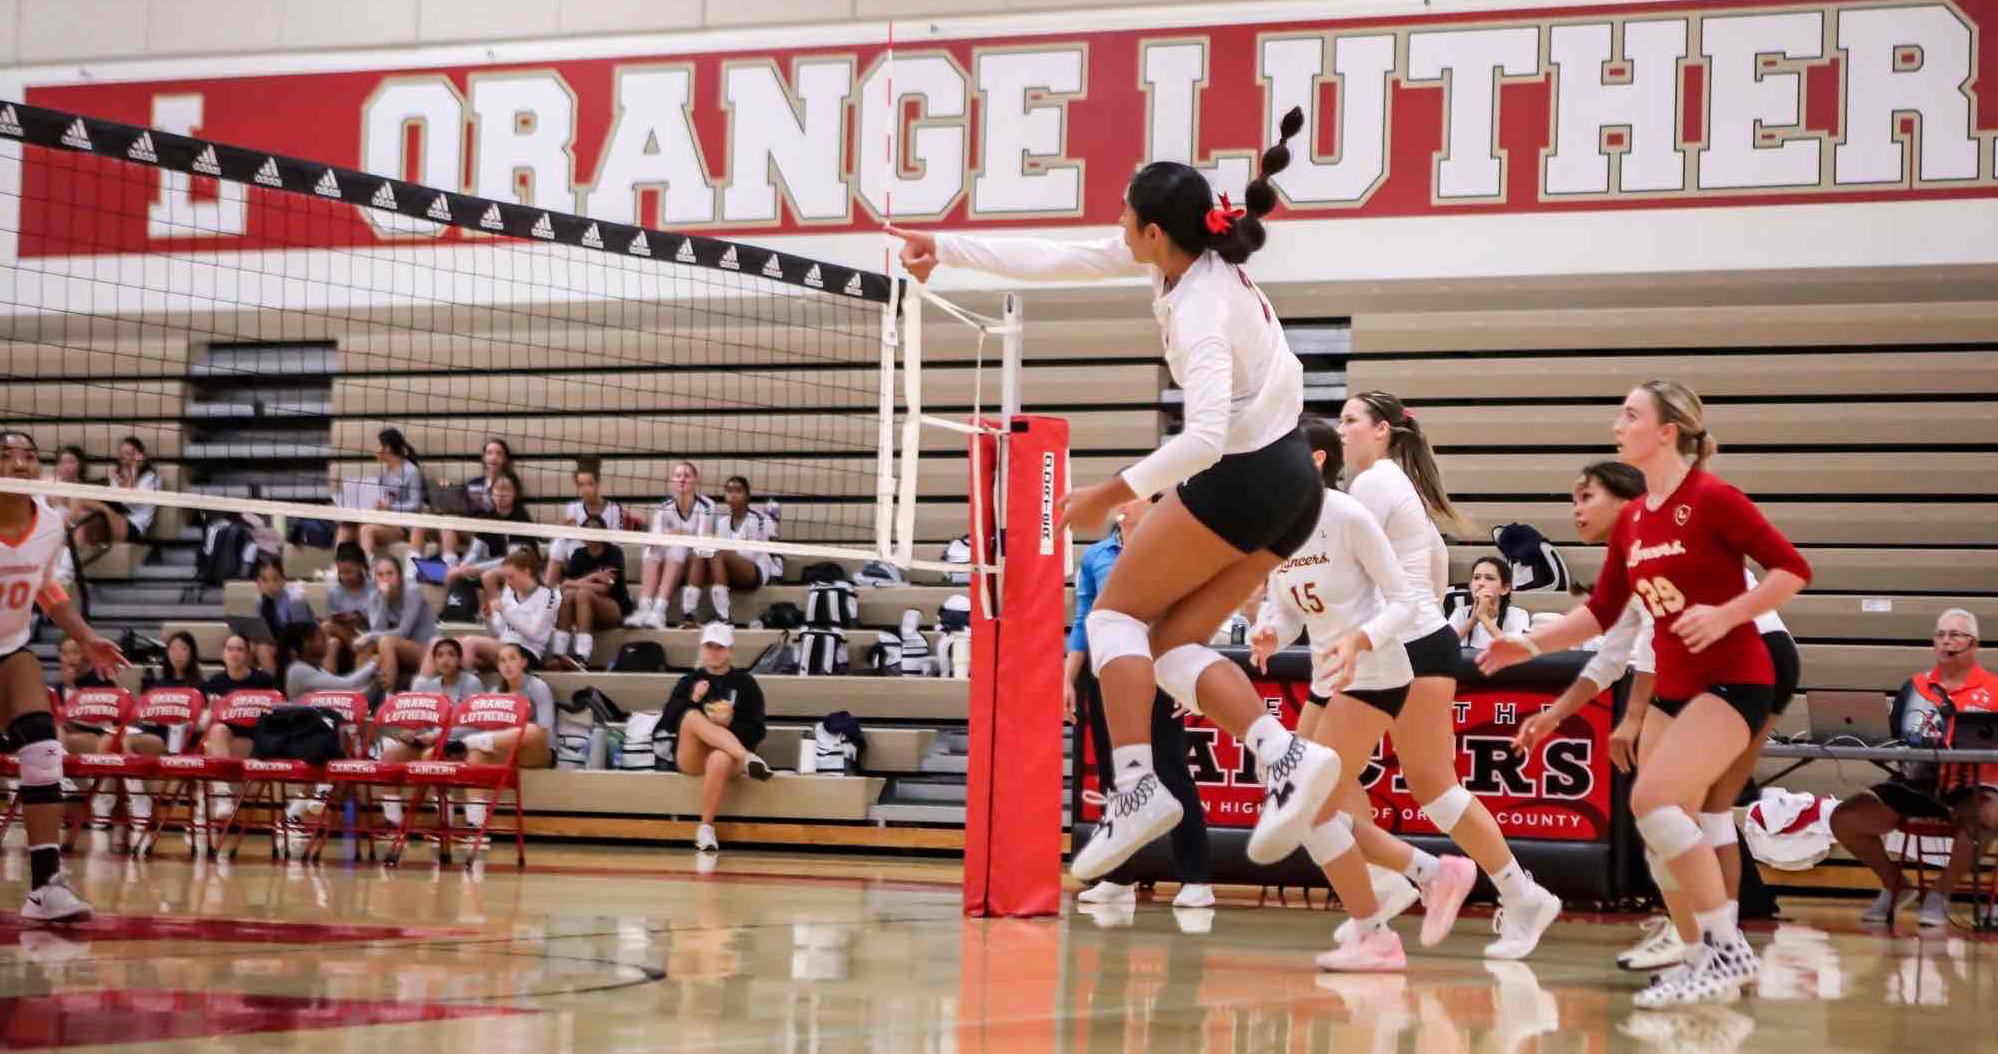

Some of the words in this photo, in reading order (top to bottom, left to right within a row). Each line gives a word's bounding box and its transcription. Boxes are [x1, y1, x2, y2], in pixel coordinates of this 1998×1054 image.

[361, 43, 1089, 240] ORANGE
[1138, 0, 1998, 210] LUTHER
[1290, 582, 1324, 613] 15
[1636, 576, 1686, 618] 29
[395, 698, 438, 710] ORANGE
[471, 698, 516, 711] ORANGE
[385, 709, 440, 723] LUTHERAN
[459, 710, 518, 724] LUTHERAN
[1496, 811, 1581, 828] COUNTY
